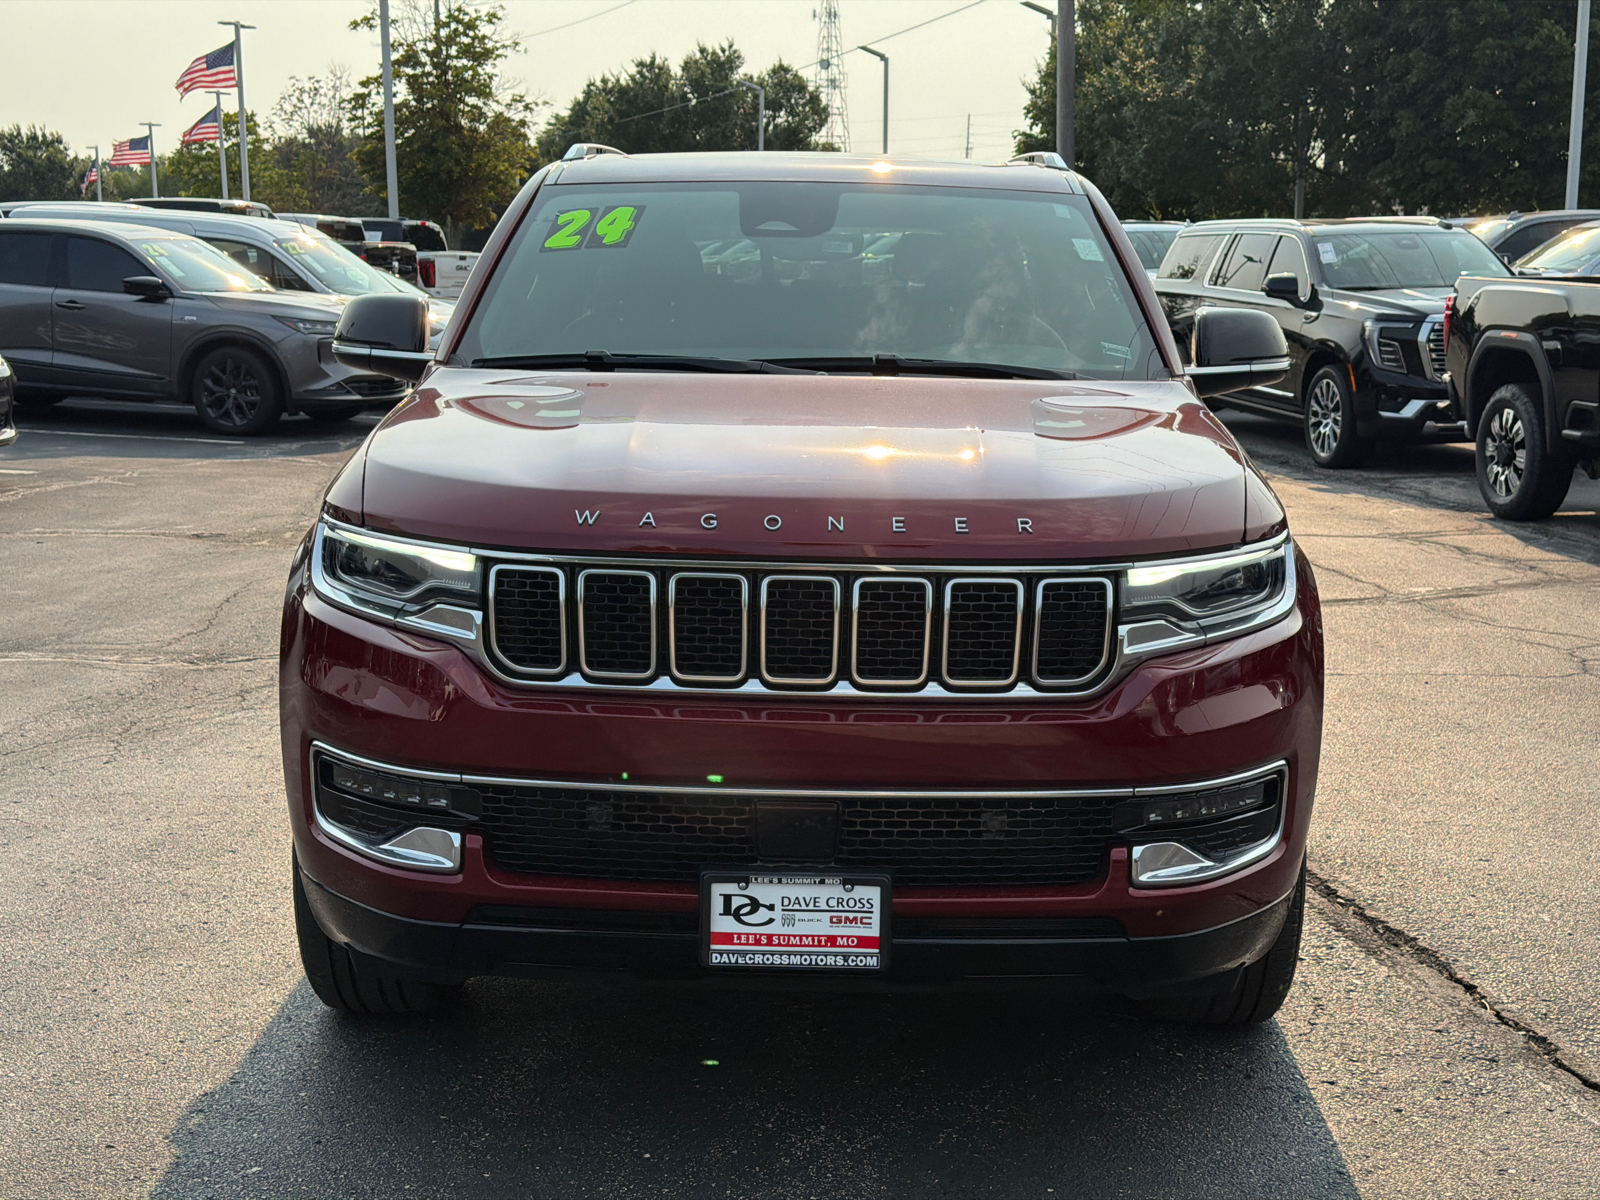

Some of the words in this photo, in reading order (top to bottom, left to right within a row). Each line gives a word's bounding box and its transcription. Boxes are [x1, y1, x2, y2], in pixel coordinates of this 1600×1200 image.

[544, 206, 637, 250] 24
[574, 508, 1034, 534] WAGONEER
[781, 877, 820, 885] SUMMIT
[781, 896, 821, 908] DAVE
[825, 897, 874, 909] CROSS
[829, 915, 873, 926] GMC
[733, 934, 768, 944] LEE'S
[772, 935, 831, 947] SUMMIT,
[836, 936, 858, 946] MO
[711, 953, 878, 967] DAVECROSSMOTORS.COM
